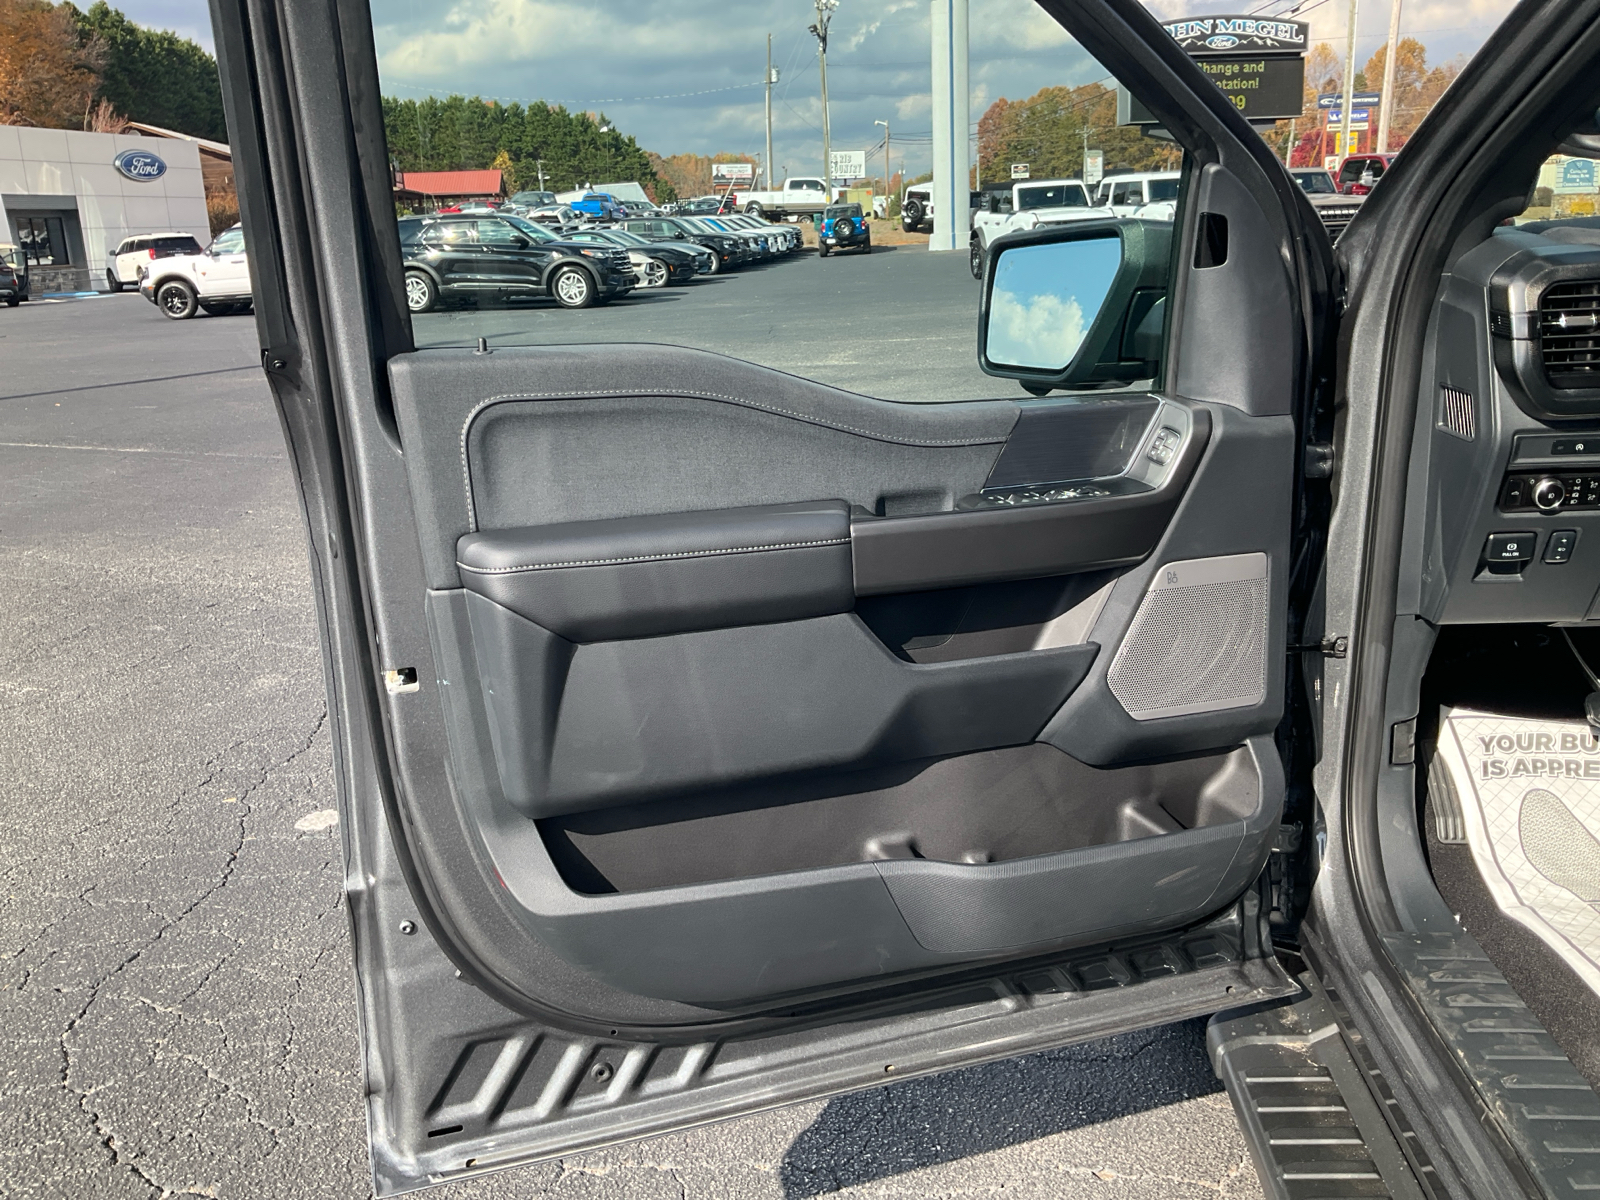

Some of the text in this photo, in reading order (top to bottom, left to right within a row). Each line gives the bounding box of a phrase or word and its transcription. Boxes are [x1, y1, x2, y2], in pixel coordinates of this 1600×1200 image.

[1215, 19, 1305, 43] MEGEL
[1211, 37, 1233, 48] Ford
[1243, 61, 1265, 73] and
[1213, 77, 1260, 90] otation!
[131, 157, 159, 175] Ford
[1477, 732, 1556, 754] YOUR
[1481, 757, 1600, 780] IS APPRE
